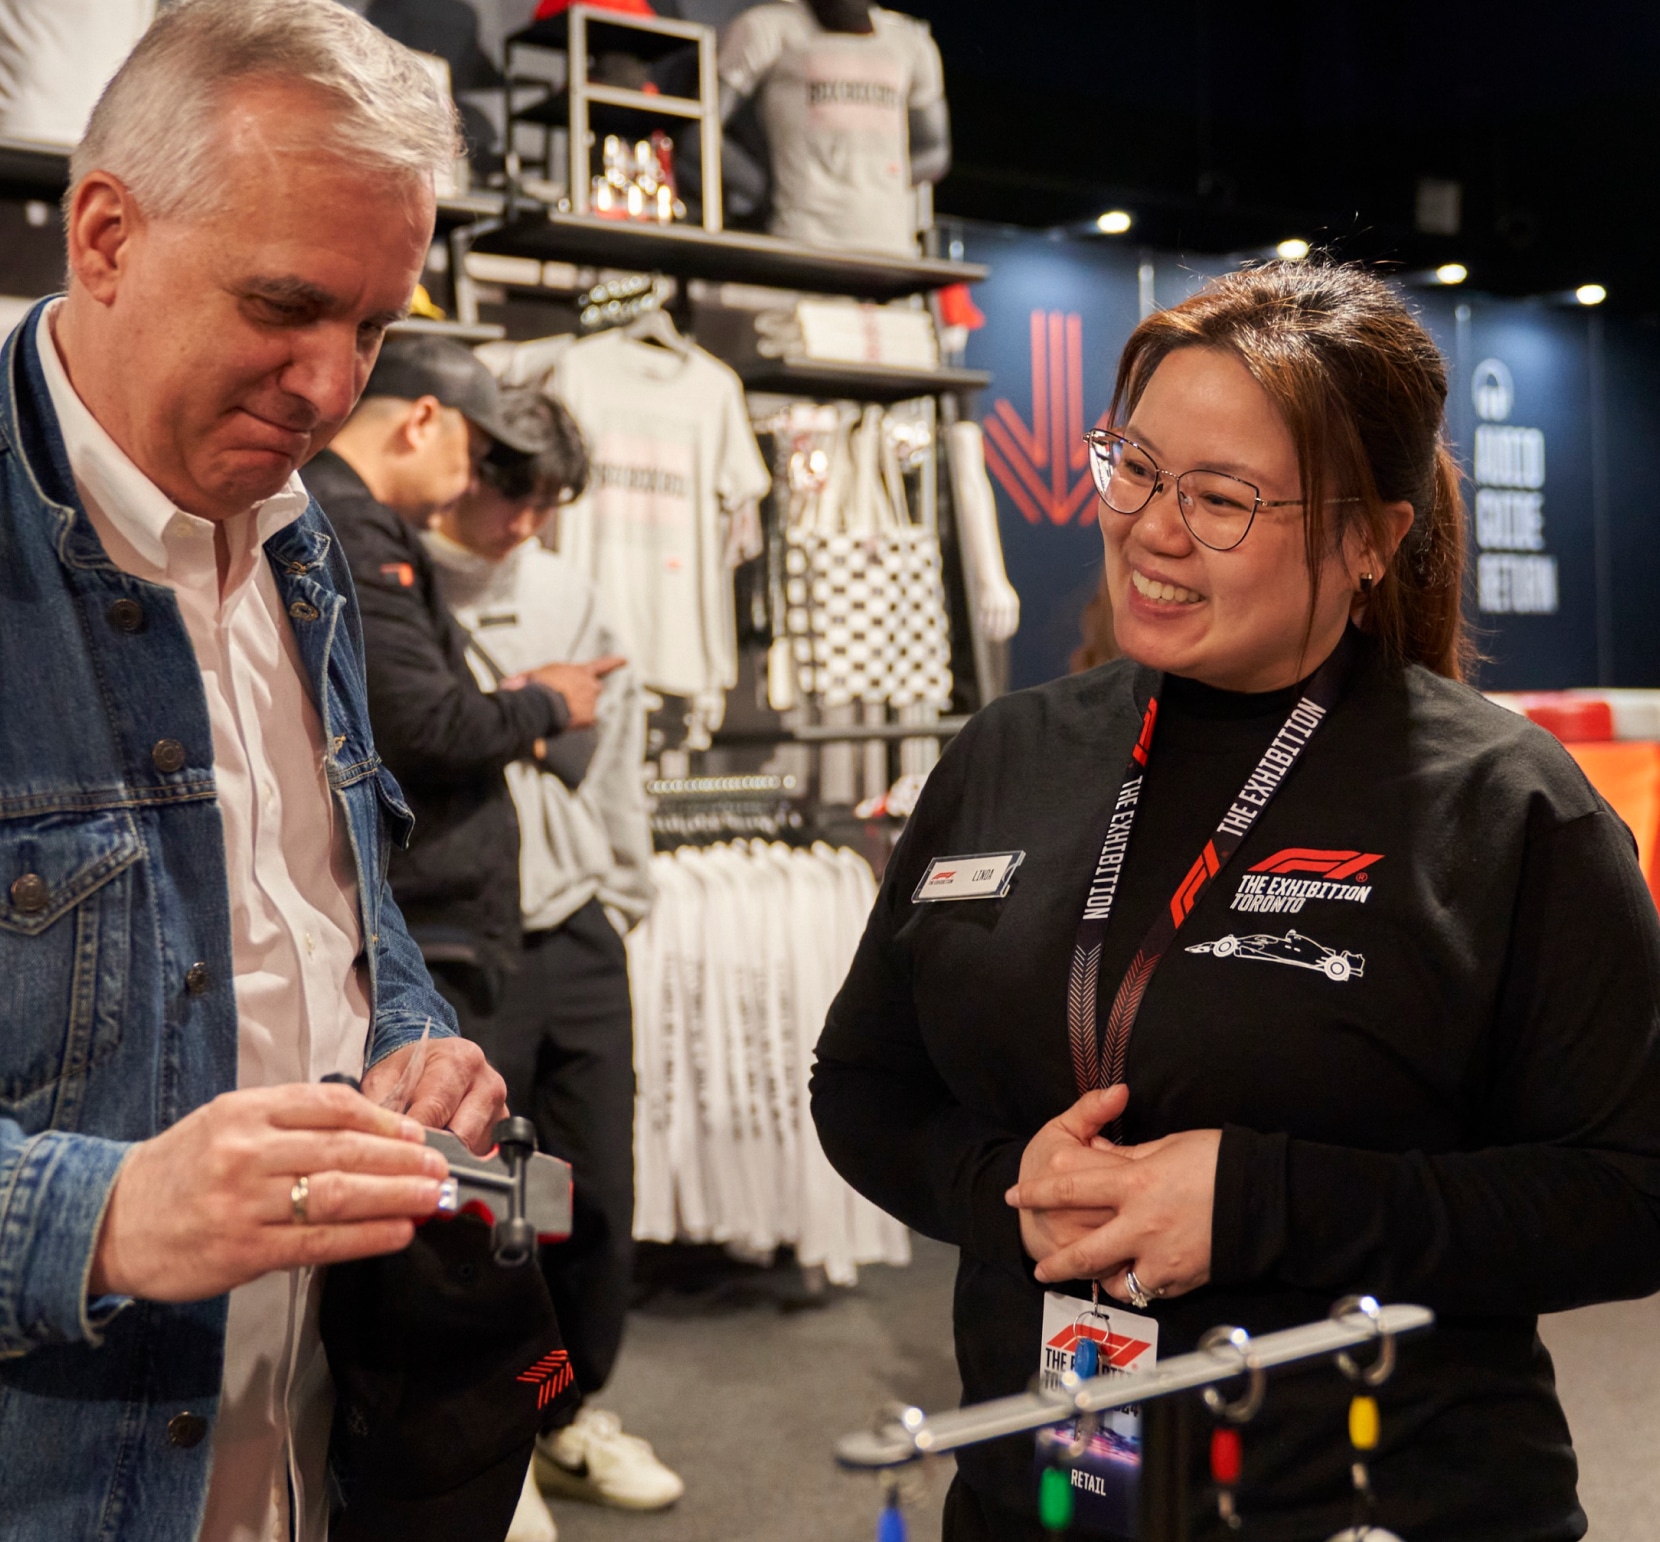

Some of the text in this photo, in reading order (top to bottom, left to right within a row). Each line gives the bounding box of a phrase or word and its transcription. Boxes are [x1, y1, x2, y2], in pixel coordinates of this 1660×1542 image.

[1216, 802, 1258, 837] THE
[1238, 697, 1327, 807] EXHIBITION
[1082, 775, 1143, 920] THE EXHIBITION
[972, 868, 995, 882] LINDA
[1237, 874, 1373, 904] THE EXHIBITION
[1229, 892, 1307, 914] TORONTO
[1045, 1347, 1067, 1372] THE
[1070, 1468, 1107, 1497] RETAIL
